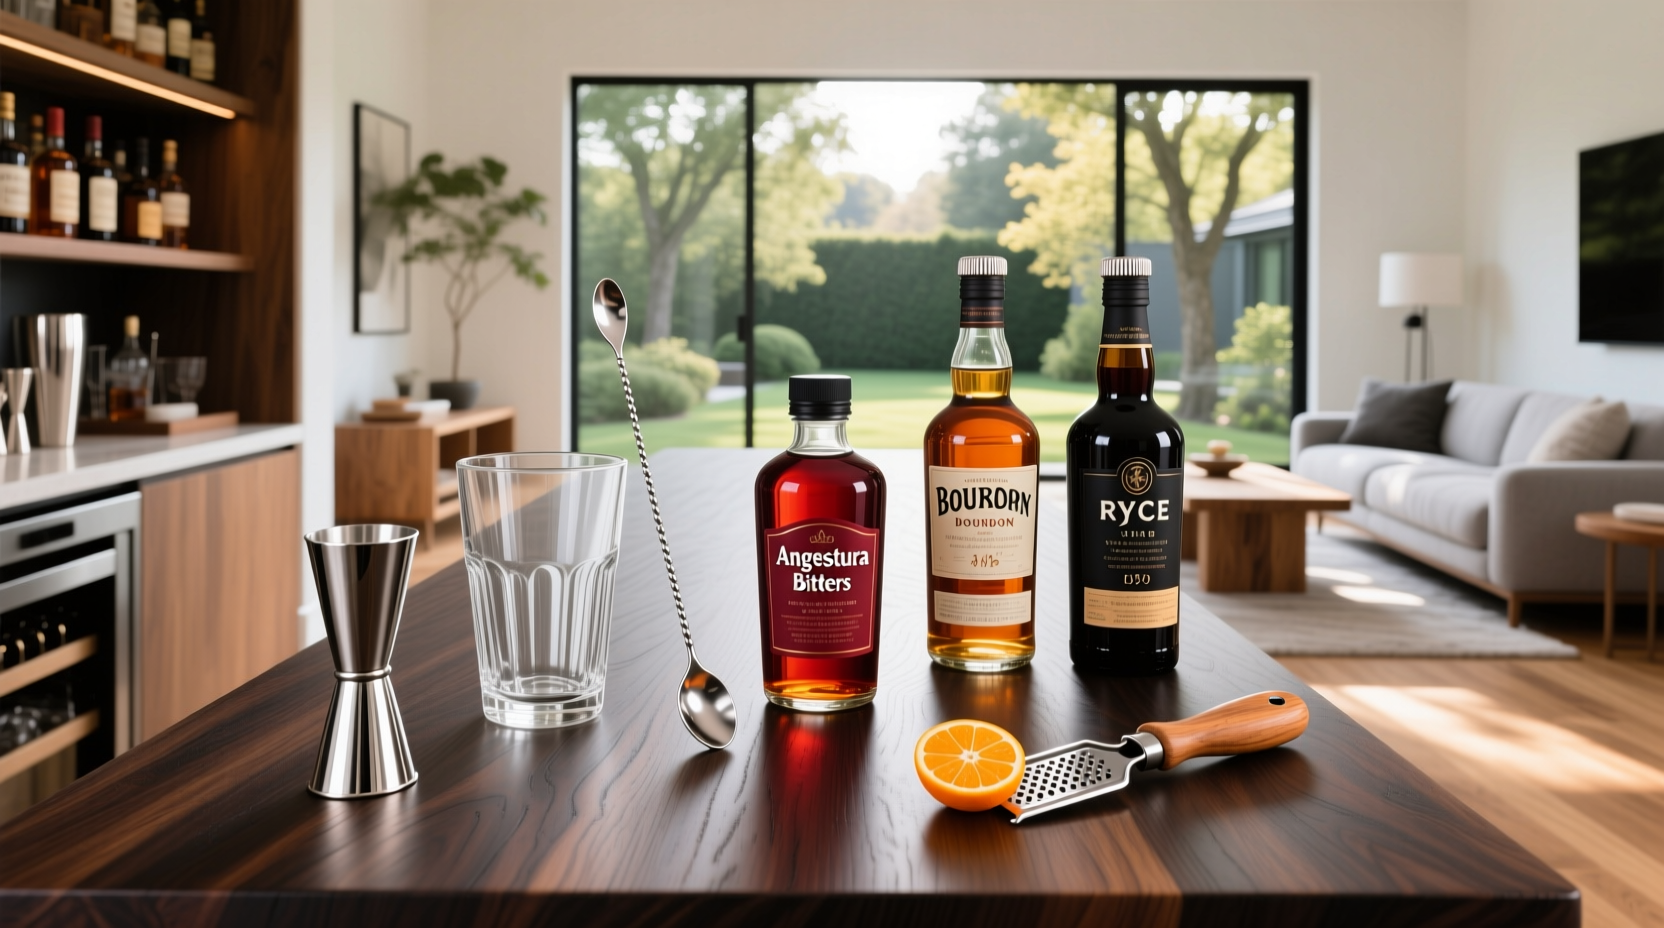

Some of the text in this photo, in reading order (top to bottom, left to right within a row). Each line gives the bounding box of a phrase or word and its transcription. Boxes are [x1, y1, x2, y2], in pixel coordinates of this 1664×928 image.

[1100, 499, 1170, 527] RYCE
[776, 545, 869, 573] Angestura
[793, 572, 852, 592] Bitters
